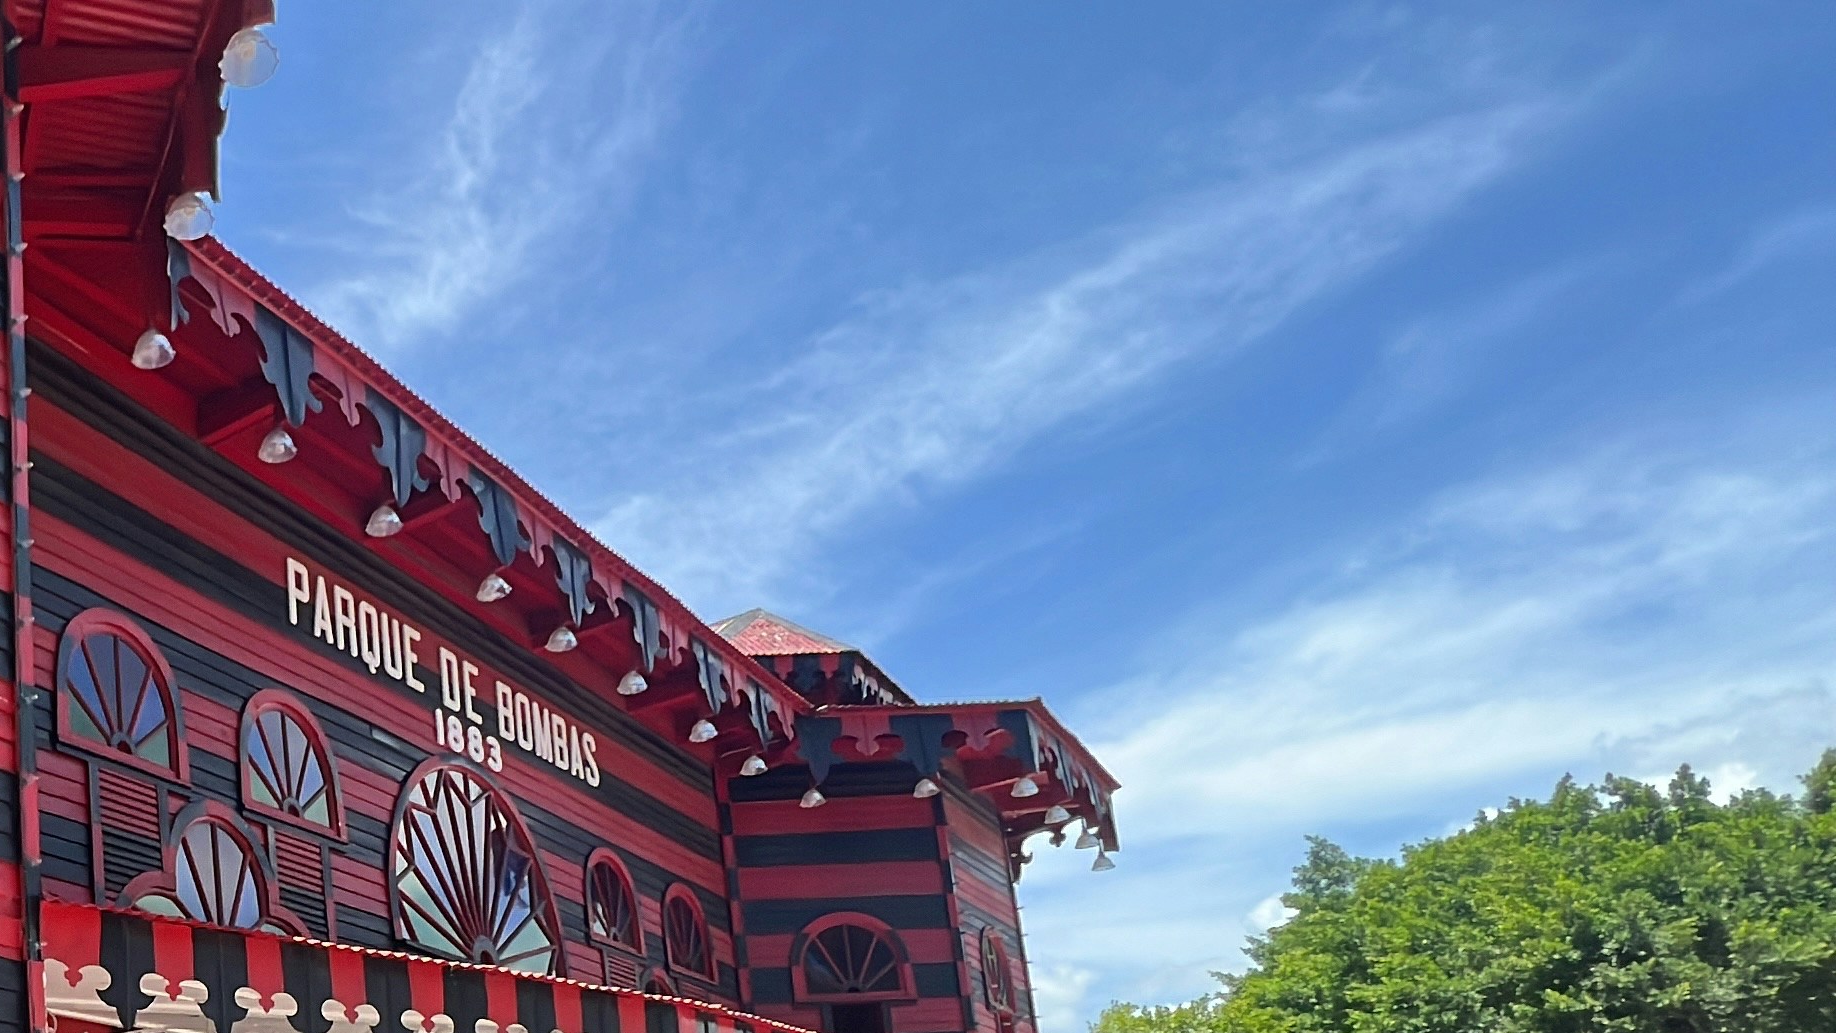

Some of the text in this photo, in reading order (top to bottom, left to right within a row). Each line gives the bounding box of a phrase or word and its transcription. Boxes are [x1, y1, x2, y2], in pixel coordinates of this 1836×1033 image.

[286, 557, 601, 788] PARQUE DE BOMBAS
[435, 708, 503, 773] 1883
